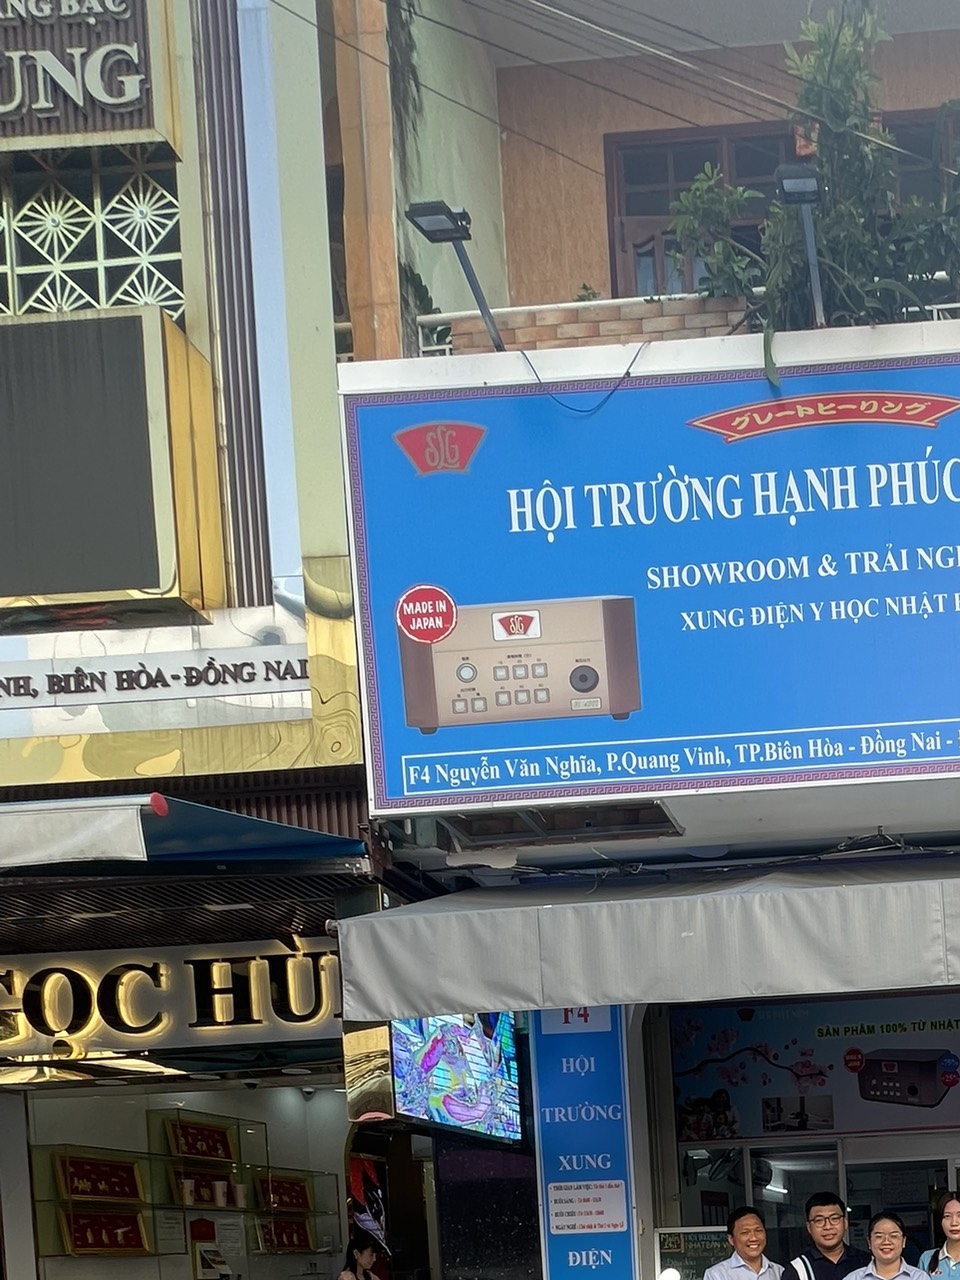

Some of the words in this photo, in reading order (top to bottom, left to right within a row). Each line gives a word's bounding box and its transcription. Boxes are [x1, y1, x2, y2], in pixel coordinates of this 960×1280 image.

[507, 479, 577, 543] HỘI
[584, 465, 743, 528] TRƯỜNG
[753, 465, 859, 527] HẠNH
[646, 554, 810, 590] SHOWROOM
[817, 553, 839, 577] &
[845, 543, 909, 574] TRẢI
[403, 601, 434, 615] MADE
[436, 600, 447, 613] IN
[680, 609, 745, 632] XUNG
[750, 601, 804, 630] ĐIỆN
[812, 602, 825, 622] Y
[830, 598, 881, 625] HỌC
[885, 591, 950, 622] NHẬT
[410, 616, 443, 630] JAPAN
[45, 666, 107, 694] BIÊN
[264, 658, 309, 682] NAI
[409, 764, 431, 785] F4
[435, 755, 500, 787] Nguyễn
[505, 757, 540, 778] Văn
[545, 755, 602, 781] Nghĩa,
[606, 750, 680, 774] P.Quang
[683, 745, 731, 769] Vinh,
[734, 741, 803, 764] TP.Biên
[808, 738, 844, 758] Hòa
[860, 728, 907, 758] Đồng
[911, 730, 942, 752] Nai
[562, 1006, 589, 1024] F4
[879, 1022, 907, 1035] 100%
[930, 1018, 960, 1031] NHẬT
[562, 1054, 596, 1076] HỘI
[541, 1101, 622, 1123] TRƯỜNG
[558, 1153, 611, 1171] XUNG
[568, 1248, 612, 1269] ĐIỆN
